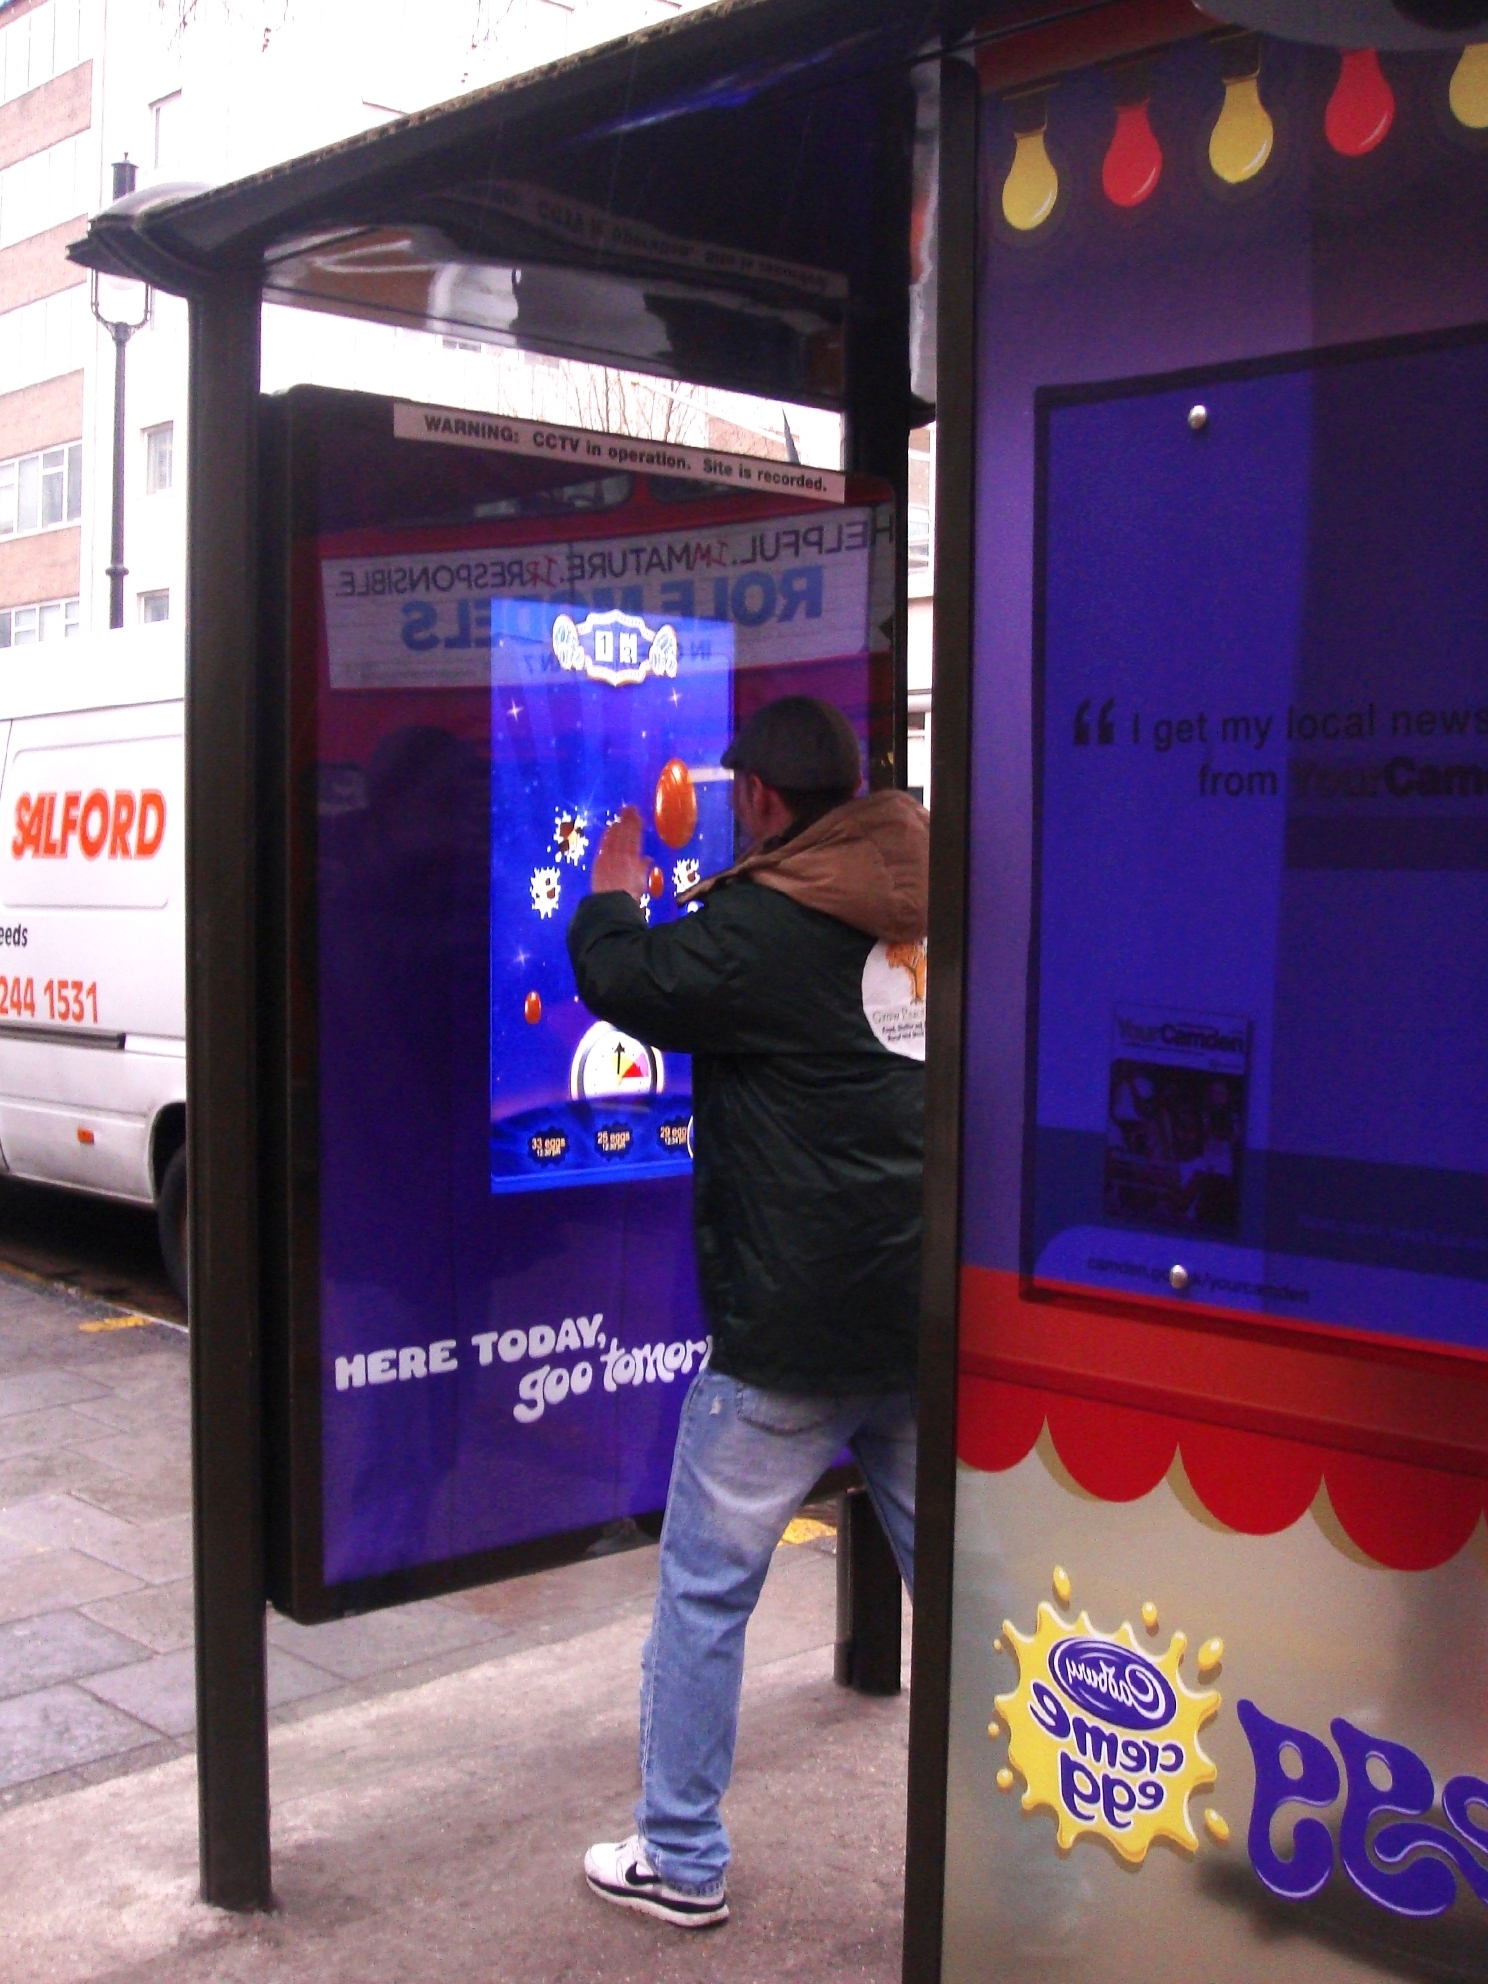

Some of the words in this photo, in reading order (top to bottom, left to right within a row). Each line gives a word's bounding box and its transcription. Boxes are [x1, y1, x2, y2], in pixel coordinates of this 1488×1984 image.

[424, 415, 519, 443] WARNING:
[533, 431, 580, 454] CCTV
[586, 440, 601, 456] in
[608, 446, 691, 470] operation.
[703, 458, 733, 476] Site
[739, 463, 752, 479] is
[757, 469, 827, 492] recorded.
[1131, 712, 1141, 744] I
[1153, 711, 1208, 753] get
[1220, 713, 1274, 751] my
[1286, 702, 1377, 739] local
[1198, 762, 1280, 797] from
[1288, 755, 1488, 799] YourCam
[11, 788, 167, 861] SALFORD
[0, 975, 35, 1018] 244
[43, 978, 98, 1024] 1531
[335, 1339, 458, 1391] HERE
[471, 1313, 606, 1367] TODAY,
[513, 1361, 594, 1424] goo
